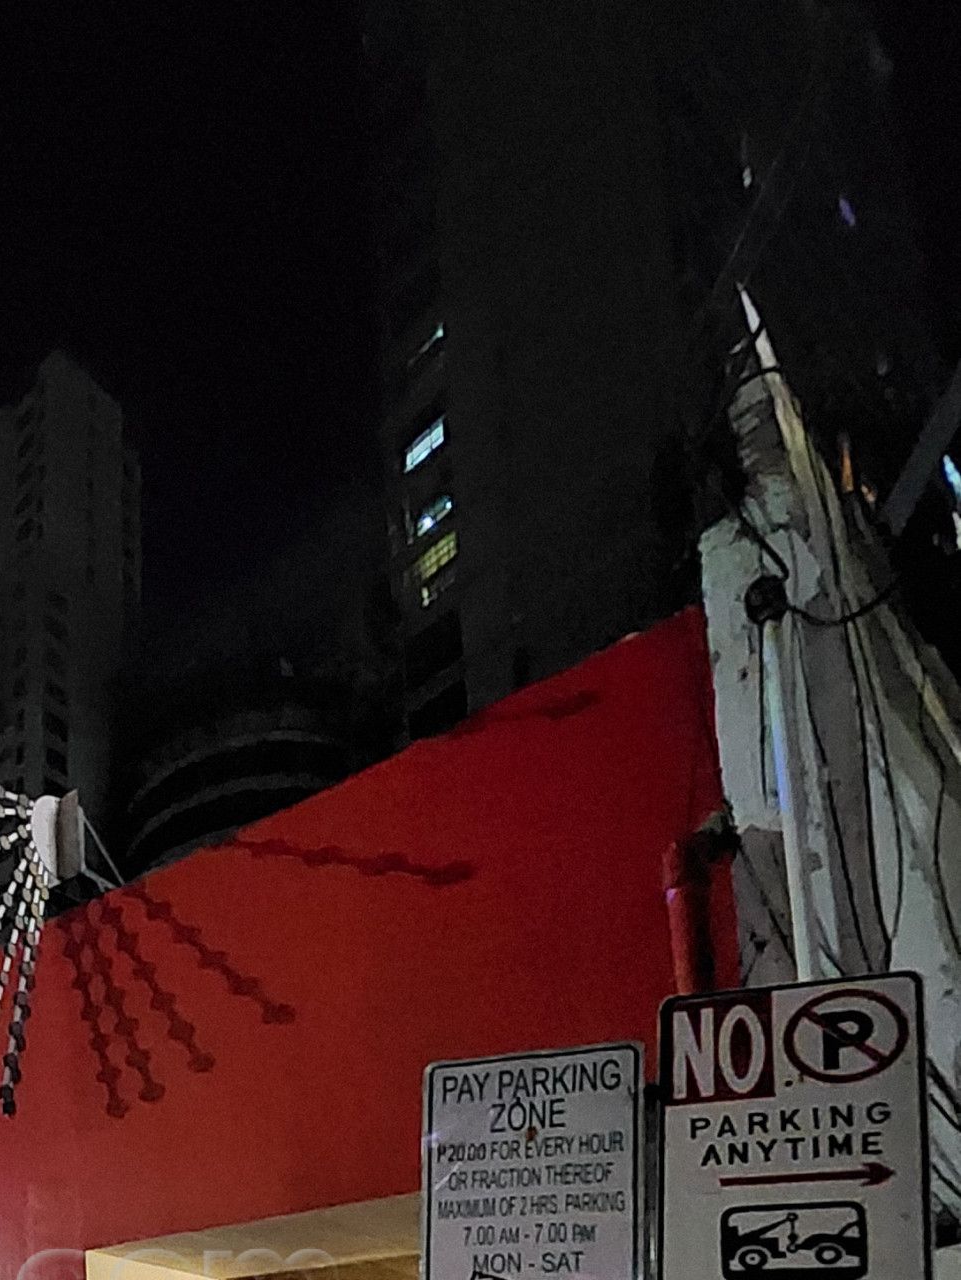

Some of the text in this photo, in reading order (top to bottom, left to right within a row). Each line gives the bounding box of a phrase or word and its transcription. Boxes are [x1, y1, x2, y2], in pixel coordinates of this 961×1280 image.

[673, 1004, 766, 1099] NO
[442, 1058, 622, 1104] PAY PARKING
[490, 1098, 566, 1134] ZONE
[690, 1102, 892, 1140] PARKING
[490, 1140, 521, 1161] FOR
[525, 1134, 576, 1159] EVERY
[579, 1130, 625, 1156] HOUR
[701, 1132, 884, 1167] ANYTIME
[448, 1162, 615, 1192] OR FRACTION THEREOF
[438, 1198, 496, 1219] MAXIMUM
[500, 1196, 517, 1217] OF
[565, 1190, 626, 1214] PARKING
[499, 1227, 521, 1244] AM
[572, 1223, 598, 1243] PM
[473, 1252, 521, 1275] MON
[541, 1250, 584, 1274] SAT
